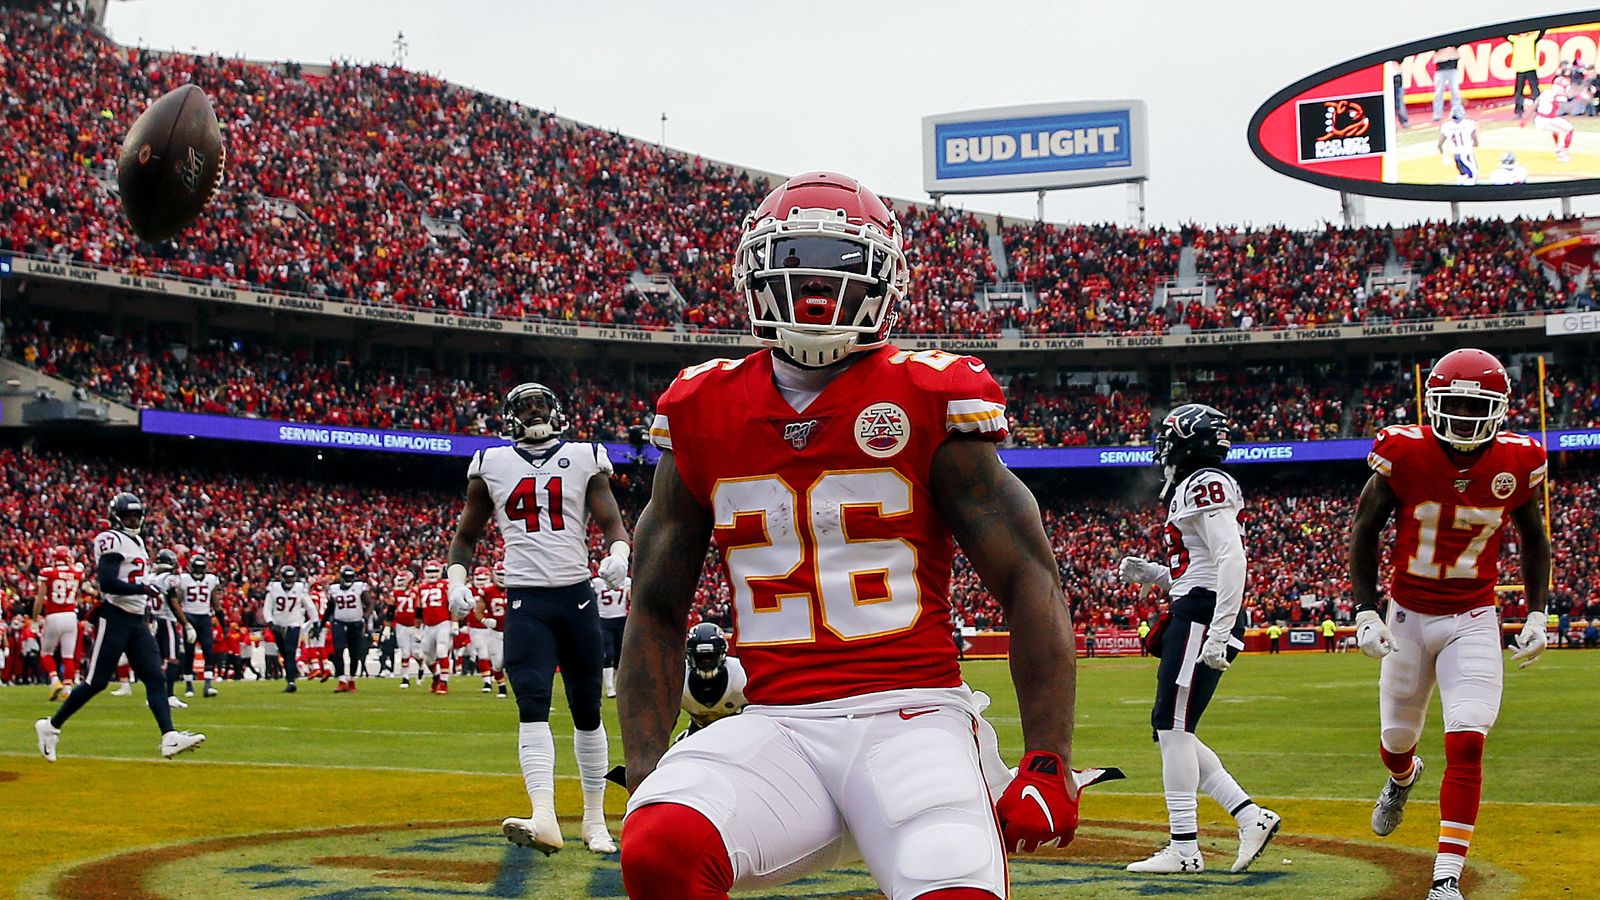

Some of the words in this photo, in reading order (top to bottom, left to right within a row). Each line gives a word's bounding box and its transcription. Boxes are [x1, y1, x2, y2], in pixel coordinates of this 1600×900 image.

[945, 134, 1017, 164] BUD
[1020, 126, 1120, 158] LIGHT
[1450, 131, 1465, 147] 41
[28, 261, 66, 277] LAMAR
[69, 267, 98, 281] HUNT
[146, 280, 165, 291] HILL
[210, 288, 237, 300] MAYS
[365, 308, 415, 322] ROBINSON
[458, 318, 503, 331] BURFORD
[1362, 326, 1393, 336] HANK
[1396, 323, 1434, 335] STRAM
[1483, 318, 1526, 328] WILSON
[545, 326, 578, 336] HOLUB
[620, 331, 653, 341] TYRER
[1211, 333, 1251, 344] LANIER
[1296, 328, 1341, 339] THOMAS
[695, 335, 741, 345] GARRETT
[940, 340, 998, 349] BUCHANAN
[1045, 339, 1084, 348] TAYLOR
[279, 426, 330, 444] SERVING
[331, 430, 382, 447] FEDERAL
[383, 434, 452, 451] EMPLOYEES
[1226, 446, 1293, 461] MPLOYEES
[1191, 481, 1226, 508] 28
[505, 476, 565, 533] 41
[99, 537, 115, 552] 27
[1406, 500, 1505, 580] 17
[710, 467, 924, 647] 26
[128, 557, 147, 585] 2
[52, 579, 79, 605] 87
[187, 585, 208, 602] 55
[420, 588, 442, 608] 72
[600, 587, 625, 605] 57
[276, 596, 297, 612] 97
[335, 594, 357, 609] 92
[397, 596, 415, 613] 71
[491, 597, 507, 616] 6
